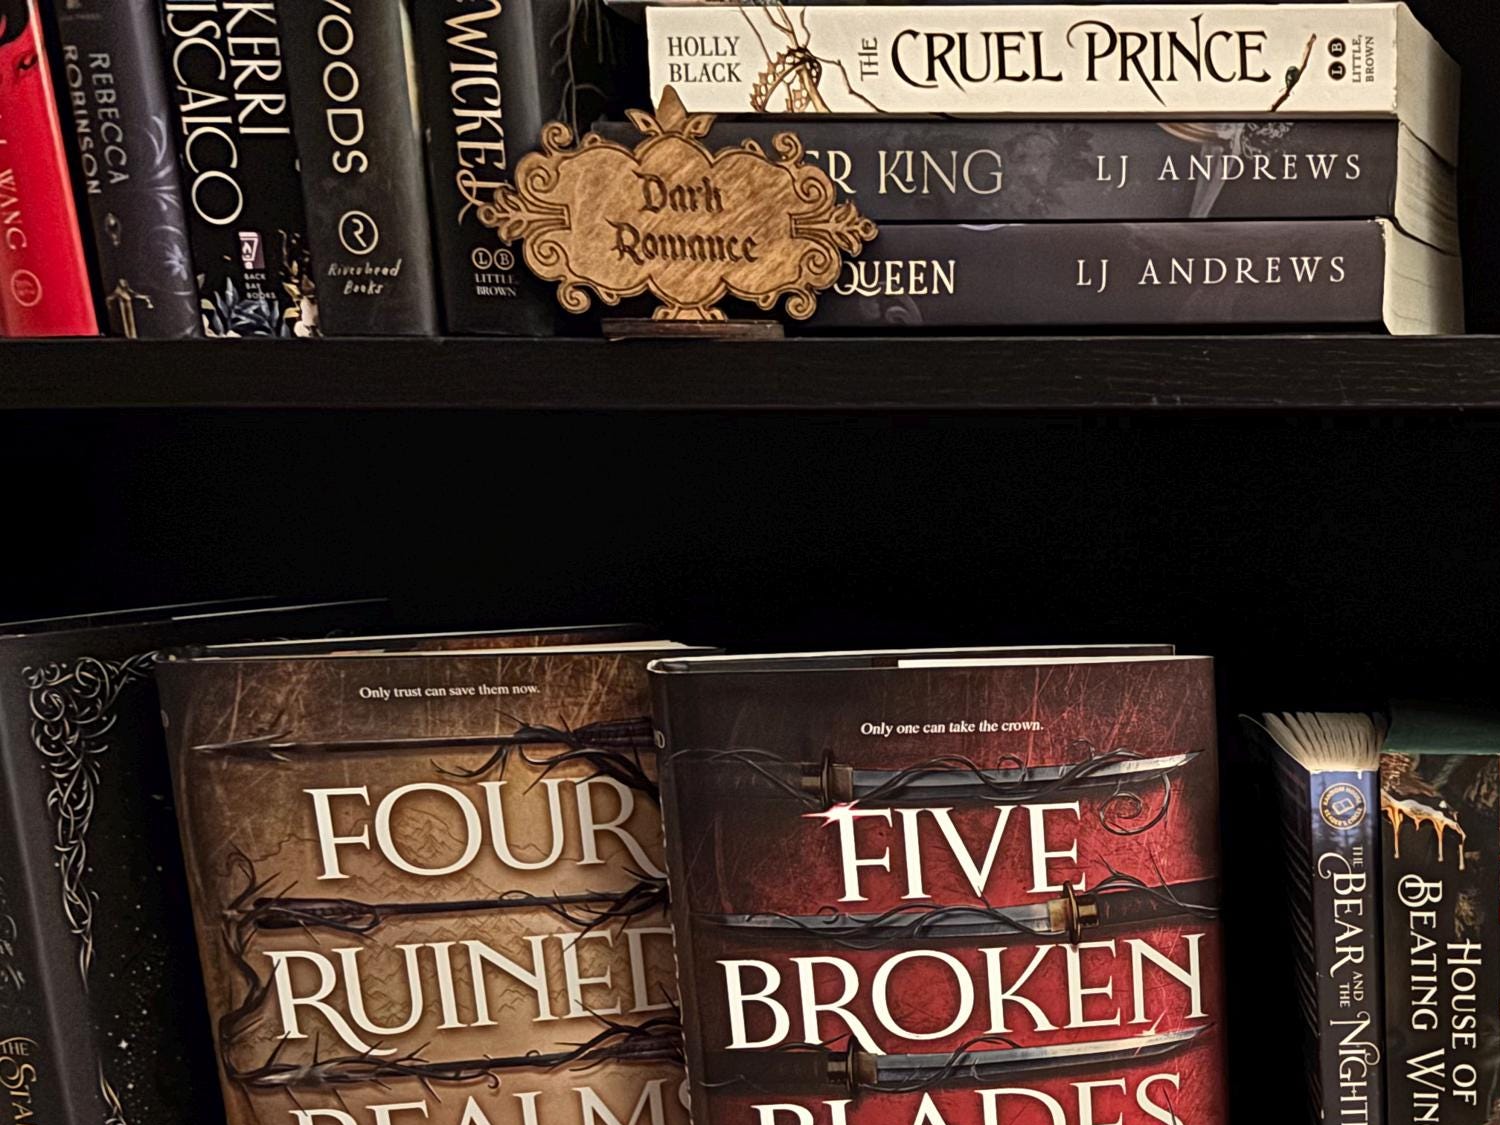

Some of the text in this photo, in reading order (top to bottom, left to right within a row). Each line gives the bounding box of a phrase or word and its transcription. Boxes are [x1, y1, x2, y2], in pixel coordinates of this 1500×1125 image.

[222, 2, 290, 134] KERRI
[667, 36, 740, 57] HOLLY
[861, 14, 1271, 107] THE CRUEL PRINCE
[1365, 35, 1375, 83] BROWN
[668, 63, 742, 83] BLACK
[62, 44, 102, 194] ROBINSON
[88, 52, 129, 184] REBECCA
[632, 168, 724, 214] Dark
[1096, 154, 1361, 189] LJ ANDREWS
[605, 218, 758, 266] Romance
[343, 280, 384, 294] Books
[834, 260, 956, 297] QUEEN
[1076, 256, 1345, 293] LJ ANDREWS
[359, 683, 541, 700] Only trust can save them now.
[860, 719, 1044, 736] Only one can take the crown.
[303, 775, 668, 880] FOUR
[837, 800, 1087, 902] FIVE
[1397, 873, 1445, 1032] BEATING
[716, 933, 1209, 1056] BROKEN
